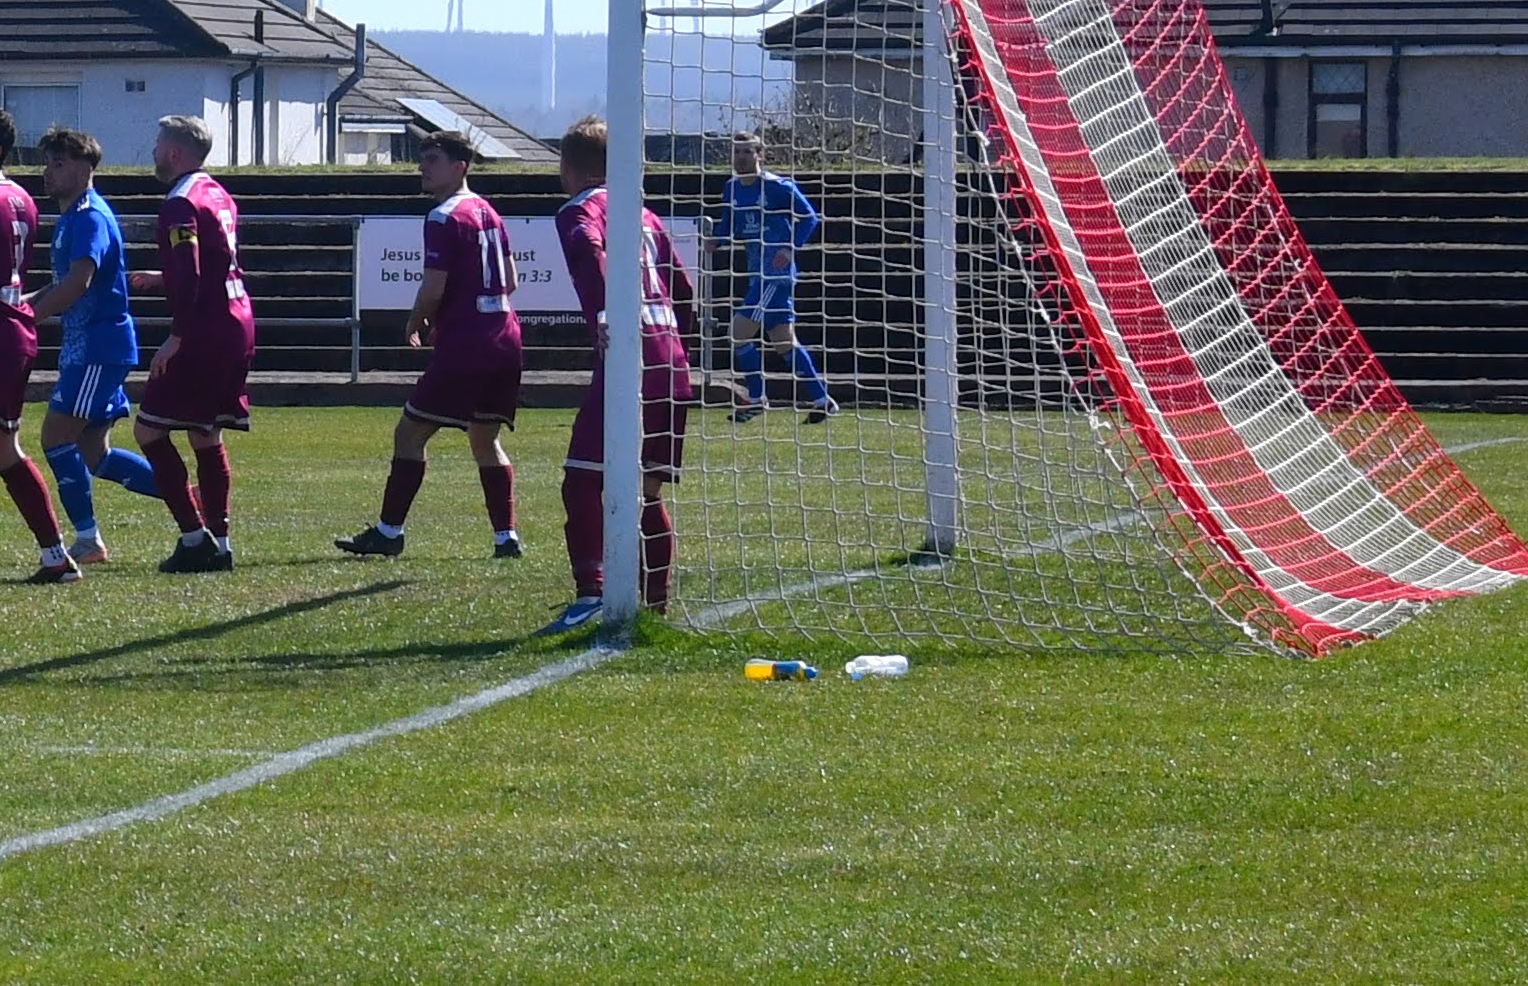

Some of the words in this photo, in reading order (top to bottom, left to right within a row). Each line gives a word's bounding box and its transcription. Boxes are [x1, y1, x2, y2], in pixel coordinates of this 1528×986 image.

[380, 248, 421, 262] Jesus
[478, 227, 506, 289] 11
[381, 269, 400, 282] be
[403, 269, 423, 282] bo
[529, 270, 553, 283] 3:3
[517, 313, 587, 326] ongregation
